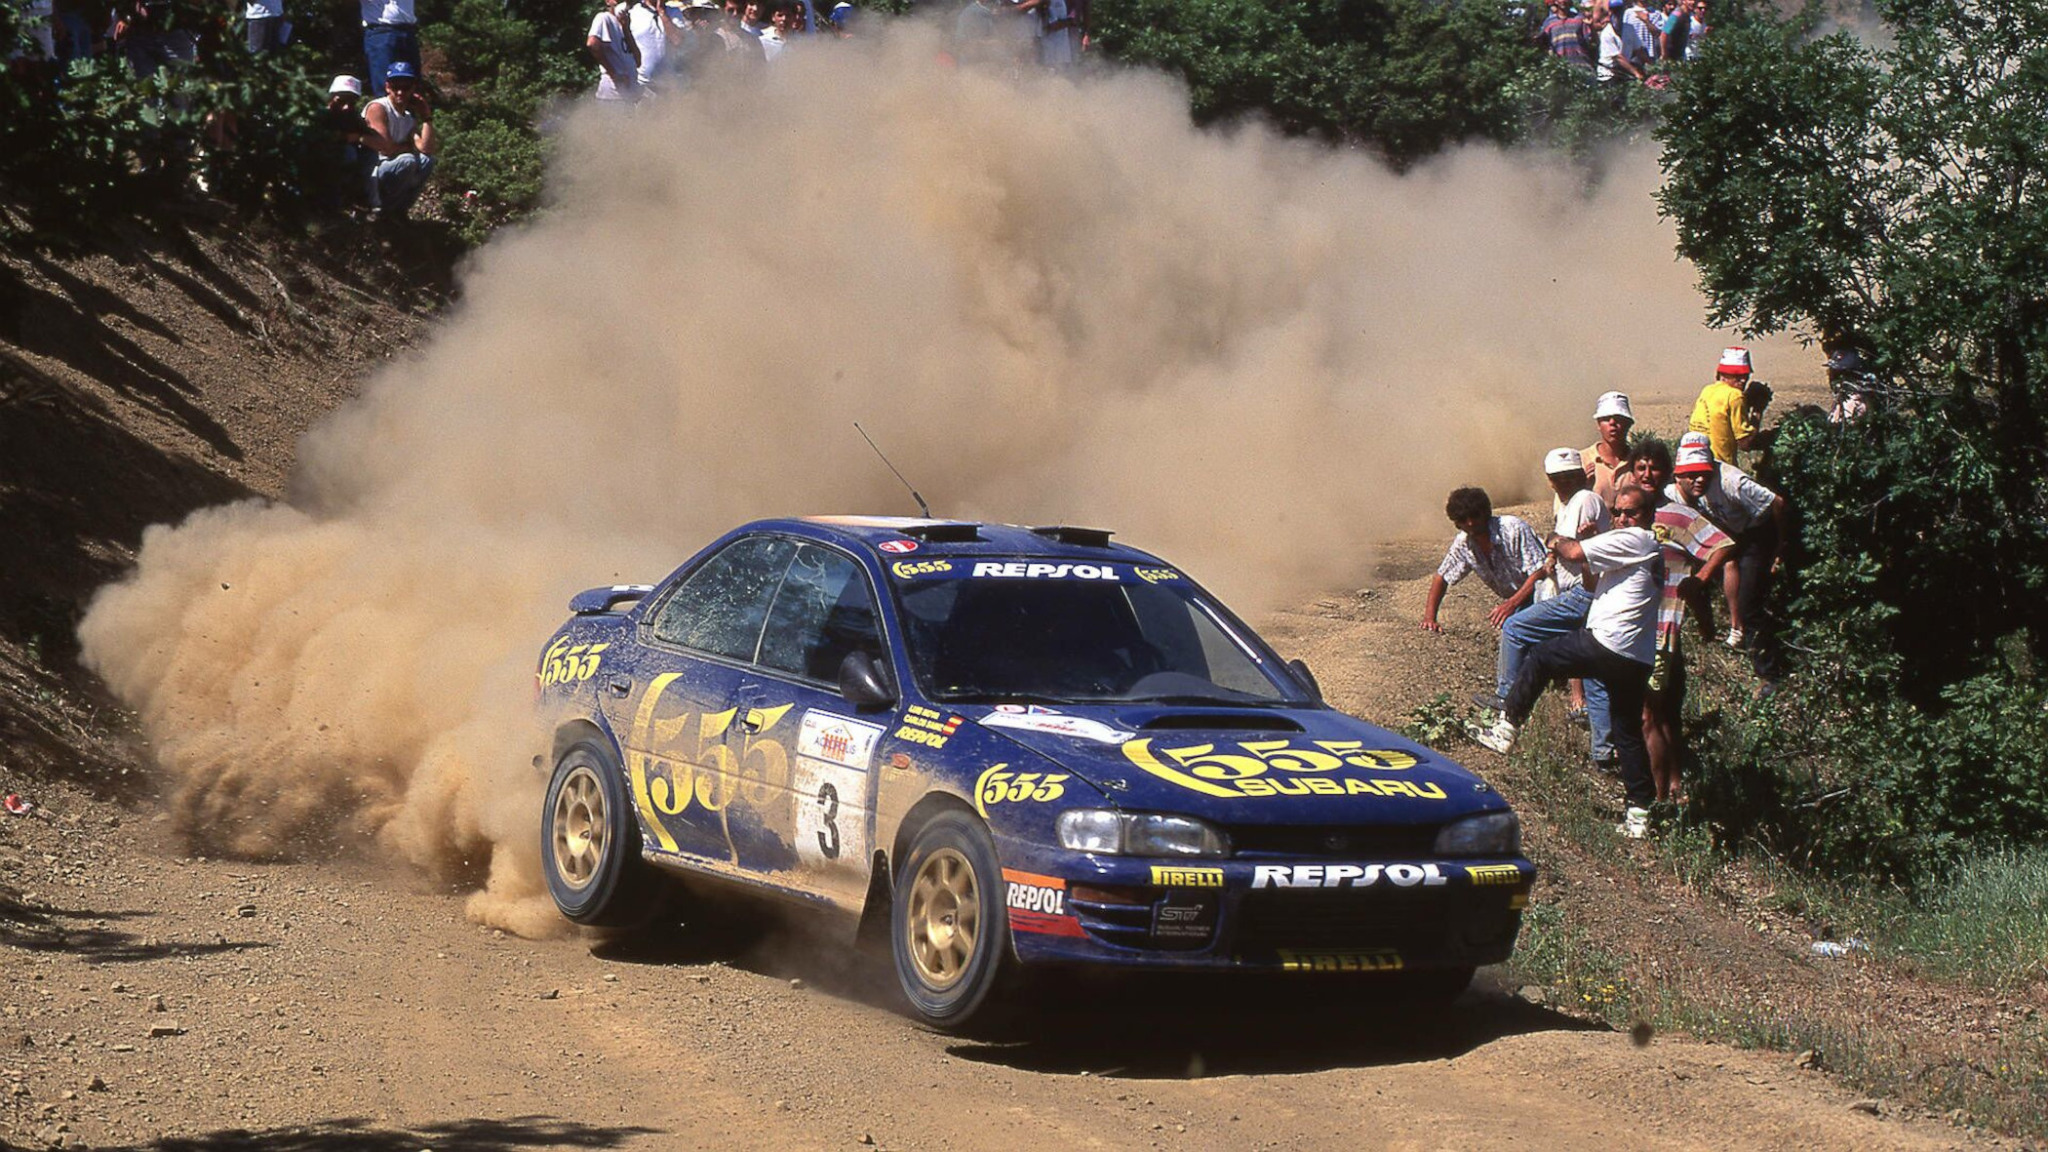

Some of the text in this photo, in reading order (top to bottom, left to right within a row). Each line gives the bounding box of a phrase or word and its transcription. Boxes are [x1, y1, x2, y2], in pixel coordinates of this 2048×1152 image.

[972, 562, 1119, 580] REPSOL
[545, 642, 611, 687] 555
[894, 725, 948, 749] REPSOL
[1159, 739, 1417, 780] 555
[982, 771, 1071, 806] 555
[1234, 778, 1447, 799] SUBARU
[817, 782, 840, 859] 3
[1150, 866, 1224, 887] PIRELLI
[1250, 864, 1448, 888] REPSOL
[1464, 864, 1521, 885] PIRELLI
[1006, 882, 1065, 915] REPSOL
[1277, 949, 1403, 970] PIRELLI
